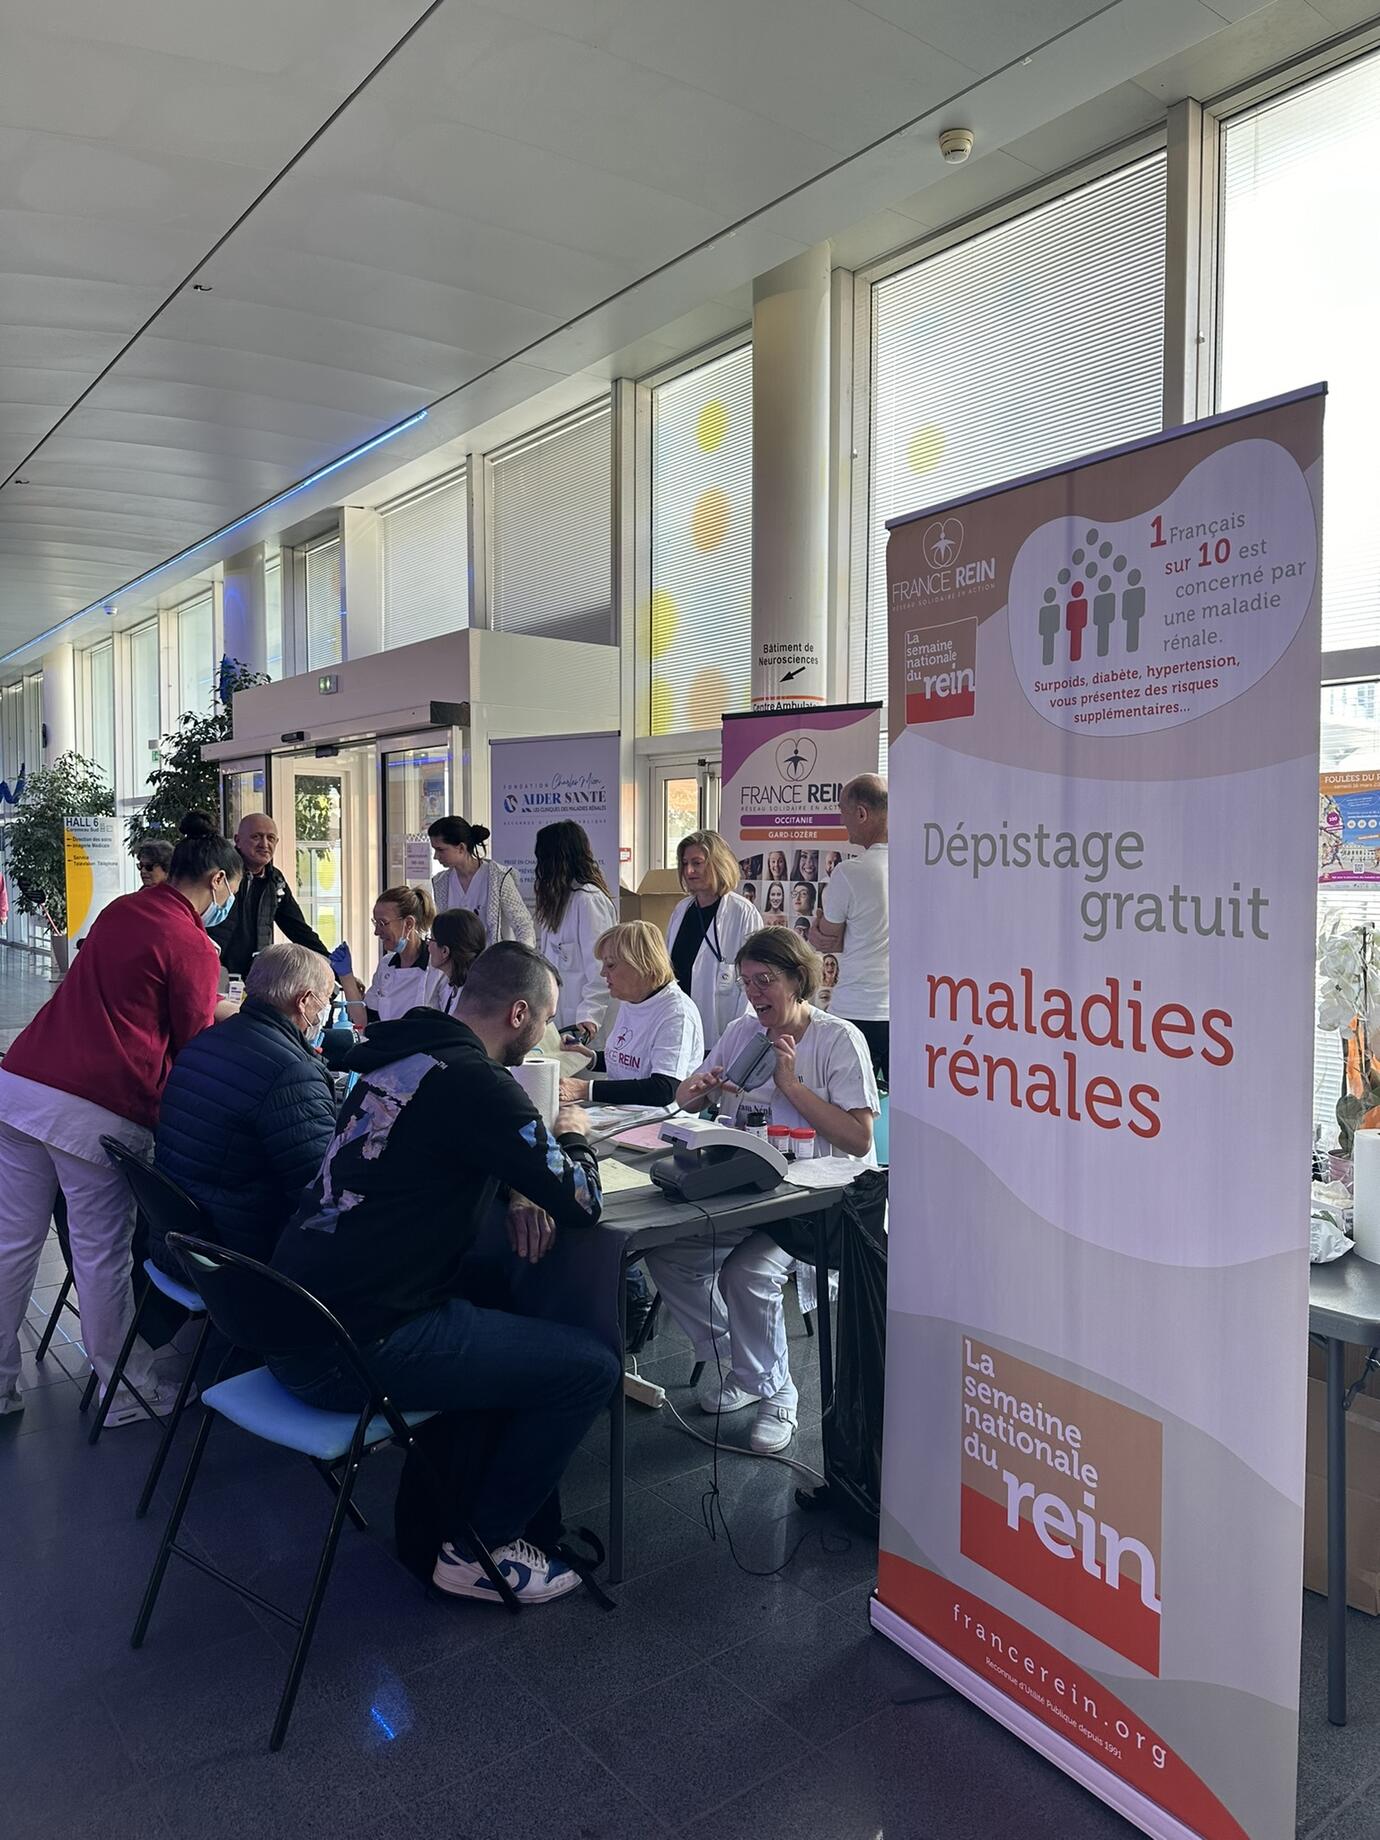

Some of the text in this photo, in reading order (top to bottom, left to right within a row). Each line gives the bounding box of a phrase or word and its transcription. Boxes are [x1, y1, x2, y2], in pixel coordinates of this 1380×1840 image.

[1150, 512, 1246, 548] 1 Français
[1165, 537, 1268, 575] sur 10 est
[892, 557, 996, 603] FRANCE REIN
[1175, 561, 1306, 598] concerné par
[1164, 592, 1281, 627] une maladie
[763, 643, 814, 653] Bâtiment de
[906, 633, 919, 644] La
[906, 640, 953, 656] semaine
[1163, 629, 1223, 652] rénale.
[758, 655, 819, 666] Neurosciences
[906, 650, 957, 669] nationale
[1034, 655, 1240, 694] Surpoids, diabète, hypertension,
[906, 662, 976, 699] du rein
[1050, 678, 1219, 708] vous présentez des risques
[1073, 702, 1190, 724] supplémentaires...
[565, 786, 607, 803] SANTÉ
[741, 784, 803, 804] FRANCE
[66, 817, 99, 827] HALL 6
[924, 821, 1144, 883] Dépistage
[1080, 882, 1269, 942] gratuit
[926, 967, 1234, 1067] maladies
[618, 1052, 640, 1069] REIN
[925, 1034, 1161, 1138] rénales
[964, 1339, 995, 1378] La
[964, 1375, 1082, 1448] semaine
[963, 1402, 1098, 1488] nationale
[964, 1432, 1162, 1615] du rein
[953, 1603, 1167, 1769] francerein.org
[985, 1656, 1018, 1686] Reconnue
[1046, 1700, 1078, 1728] Publique
[1078, 1724, 1103, 1747] depuis
[1104, 1741, 1123, 1760] 1991
